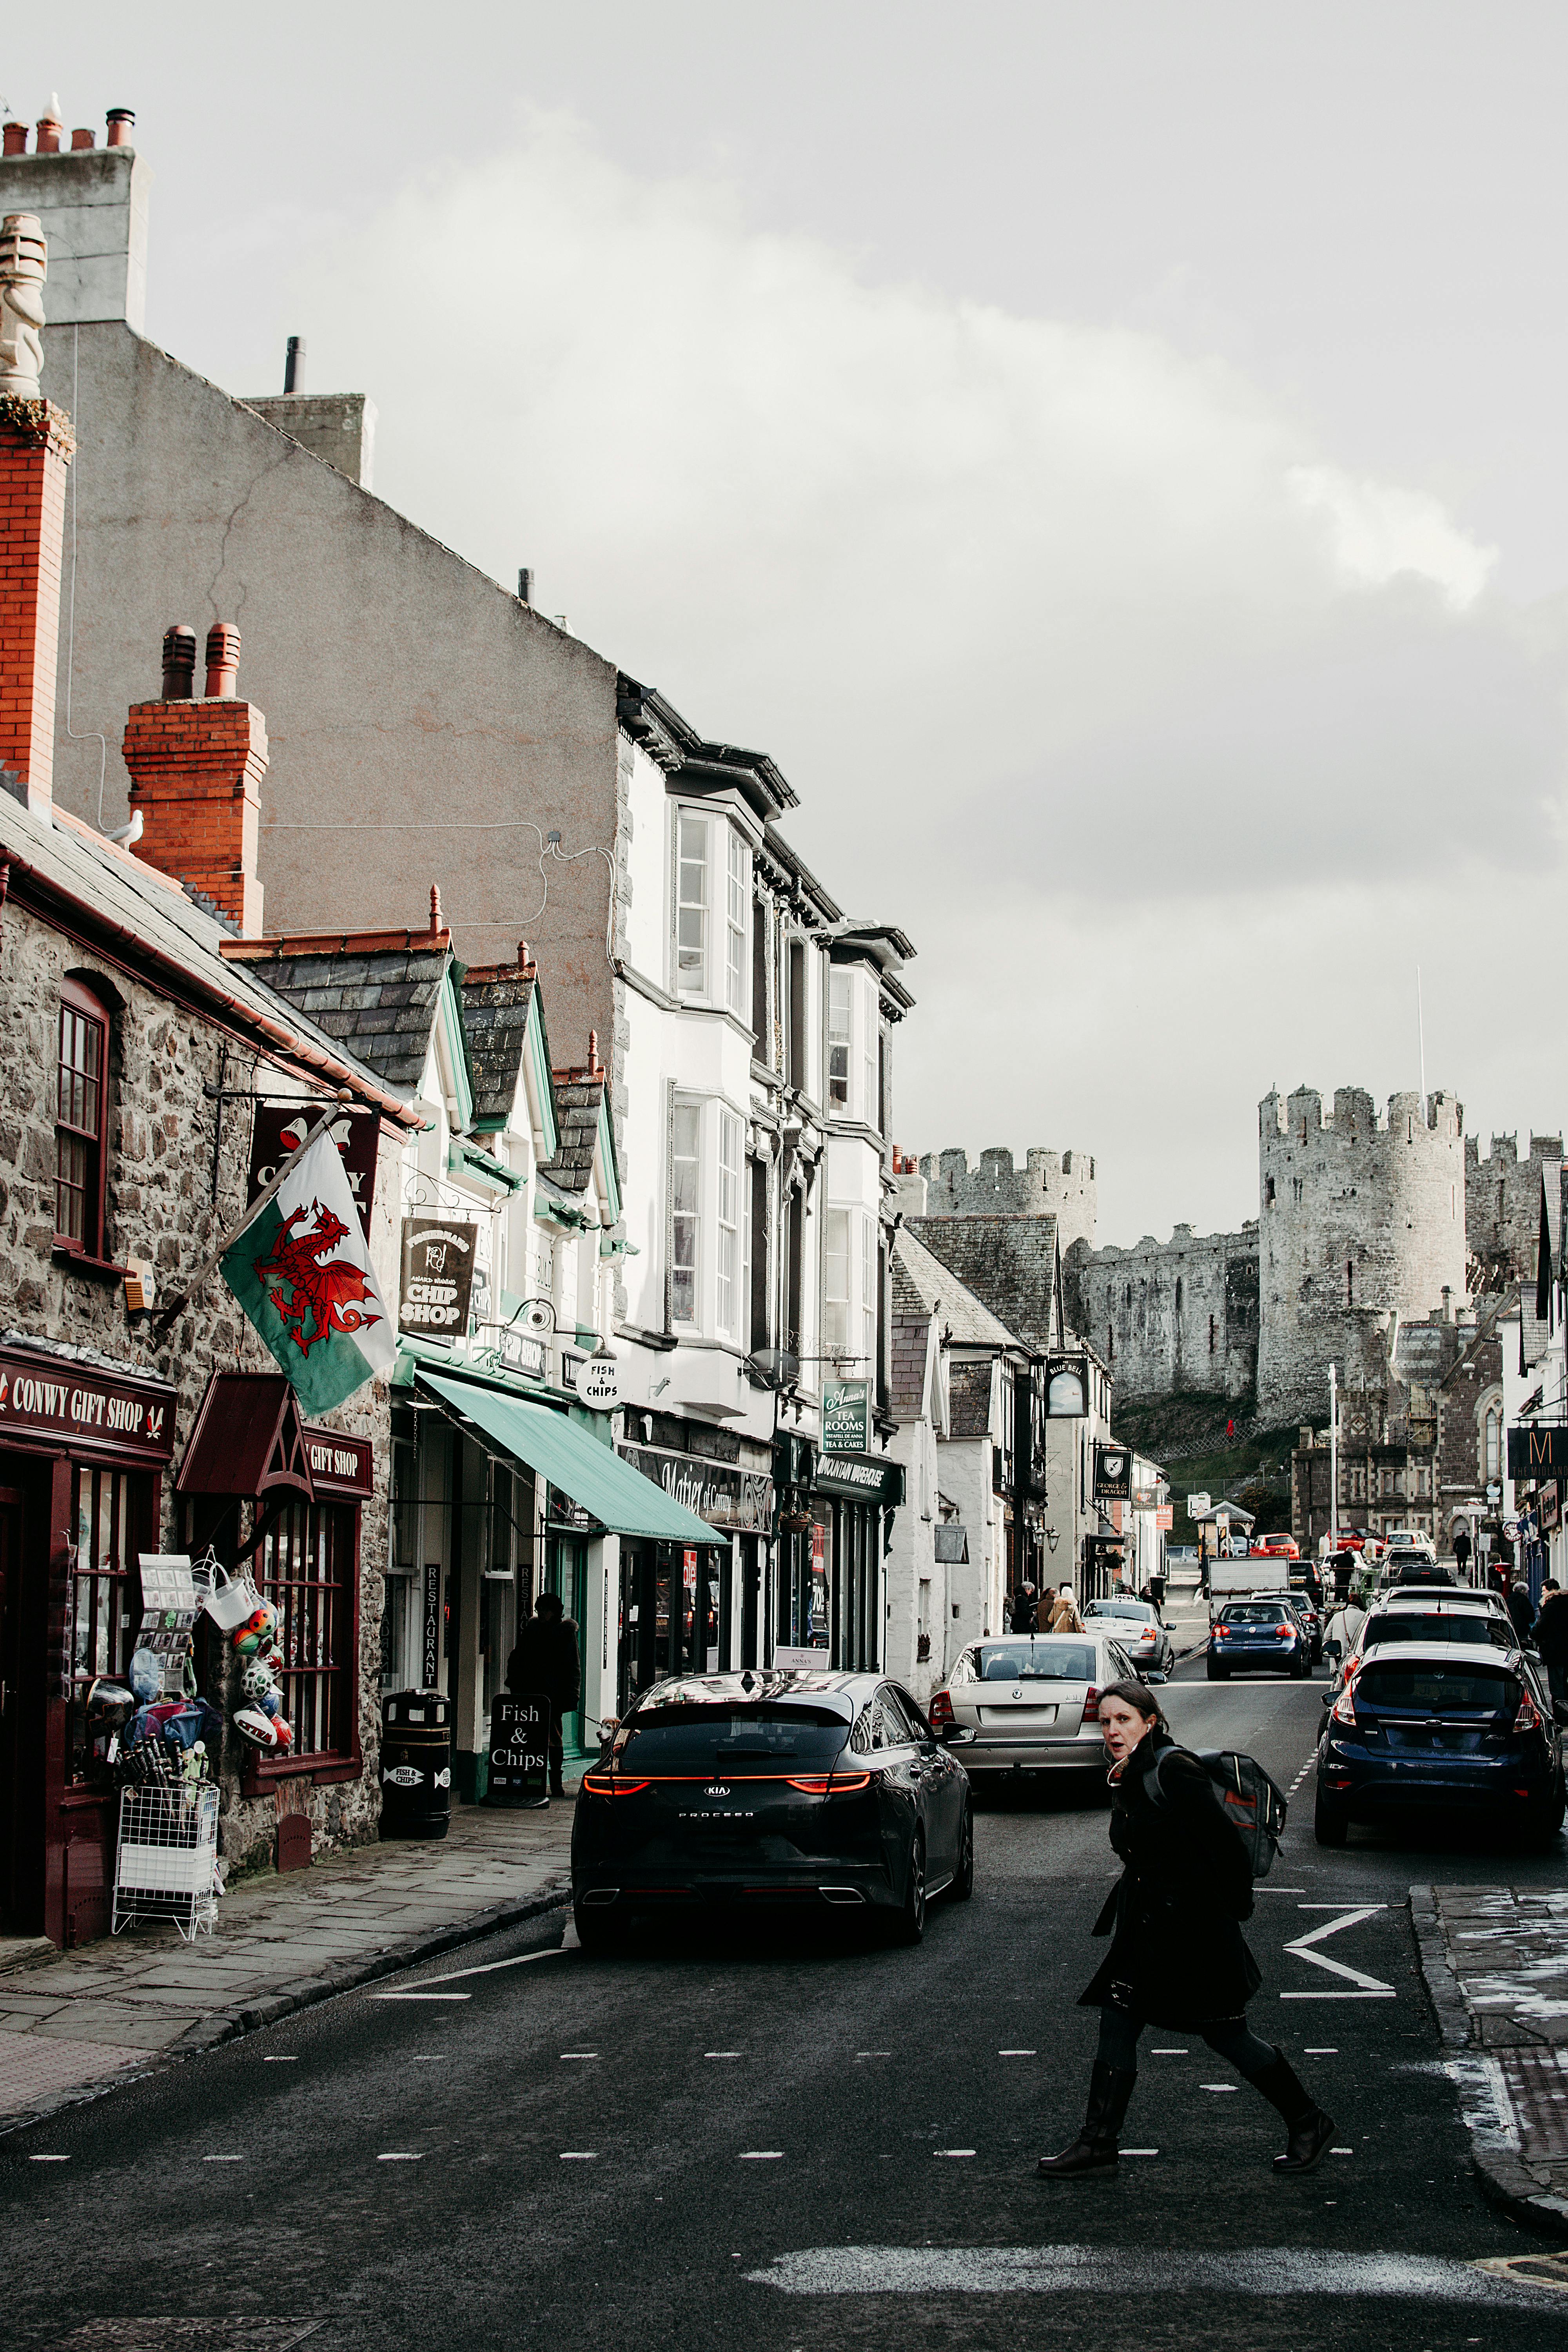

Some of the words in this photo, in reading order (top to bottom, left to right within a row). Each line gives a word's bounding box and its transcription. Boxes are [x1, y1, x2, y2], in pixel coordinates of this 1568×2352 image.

[406, 1230, 470, 1252] FISHERMANS
[407, 1284, 457, 1305] CHIP
[474, 1285, 491, 1312] CHIPS
[400, 1303, 460, 1325] SHOP
[521, 1339, 541, 1369] SHOP
[591, 1366, 615, 1376] FISH
[1049, 1365, 1066, 1374] BLUE
[1068, 1365, 1082, 1375] BELL
[586, 1386, 617, 1396] CHIPS
[826, 1387, 865, 1410] Anna's
[13, 1377, 69, 1417] CONWY
[71, 1389, 105, 1425] GIFT
[107, 1397, 143, 1432] SHOP
[836, 1411, 855, 1420] TEA
[825, 1421, 864, 1430] ROOMS
[1530, 1432, 1552, 1464] M
[311, 1445, 333, 1472] GIFT
[334, 1449, 358, 1477] SHOP
[821, 1457, 853, 1480] MOUNTAIN
[850, 1464, 884, 1487] WAREHOUSE
[1512, 1466, 1527, 1476] THE
[1531, 1466, 1568, 1476] MIDLAND
[662, 1461, 703, 1515] Matier
[704, 1483, 711, 1518] of
[711, 1485, 731, 1521] Conwy
[683, 1552, 696, 1586] ale
[520, 1568, 529, 1630] RESTAU
[426, 1568, 436, 1684] RESTAURANT
[501, 1704, 539, 1721] Fish
[237, 1719, 272, 1744] WALES
[511, 1728, 527, 1744] &
[492, 1749, 544, 1771] Chips
